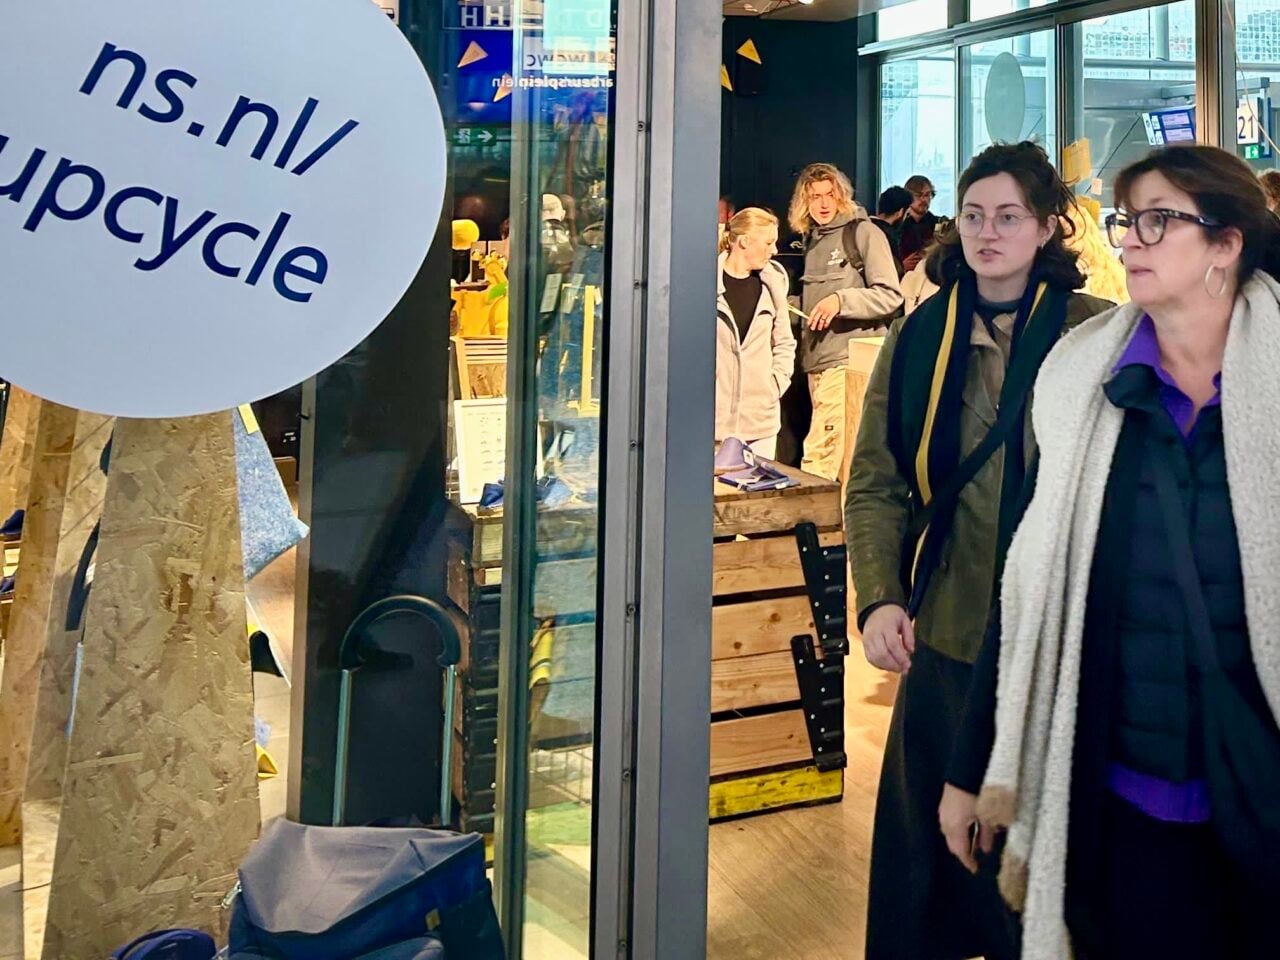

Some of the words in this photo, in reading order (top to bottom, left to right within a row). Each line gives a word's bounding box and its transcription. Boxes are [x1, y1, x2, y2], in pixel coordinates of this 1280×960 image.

[79, 41, 360, 177] ns.nl/
[1238, 115, 1254, 139] 21
[0, 133, 329, 304] upcycle
